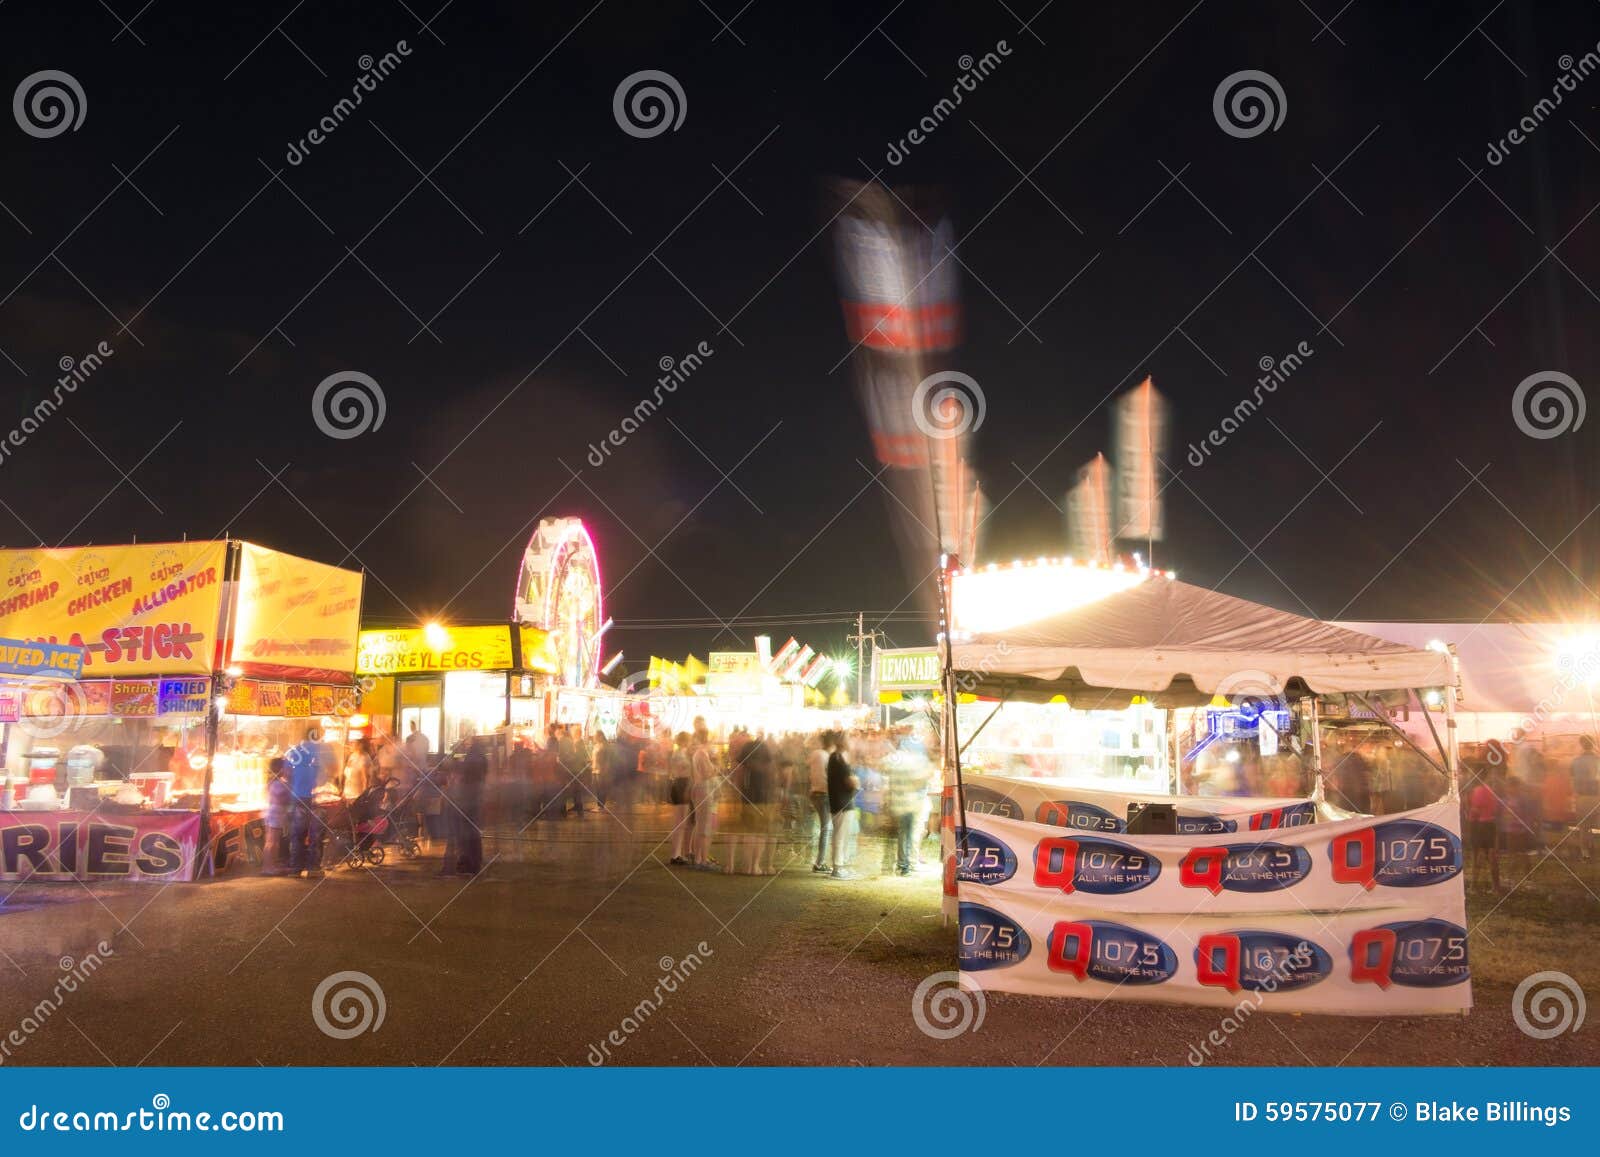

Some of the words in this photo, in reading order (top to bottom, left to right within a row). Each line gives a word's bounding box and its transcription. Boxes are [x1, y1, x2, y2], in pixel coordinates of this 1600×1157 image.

[67, 577, 133, 617] CHICKEN
[132, 567, 217, 615] ALLIGATOR
[49, 650, 80, 671] ICE
[882, 656, 939, 681] LEMONADE
[165, 682, 206, 695] FRIED
[161, 699, 207, 712] SHRIMP
[1071, 814, 1117, 830] 107.5
[1034, 837, 1080, 895] Q
[1081, 851, 1145, 870] 107.5
[1227, 851, 1291, 869] 107.5
[1332, 827, 1376, 892] Q
[1381, 837, 1448, 862] 107.5
[1404, 866, 1426, 874] THE
[1430, 865, 1457, 873] HITS
[960, 872, 980, 880] THE
[982, 872, 1007, 880] HITS
[1078, 874, 1100, 882] ALL
[1103, 874, 1124, 883] THE
[1126, 874, 1152, 883] HITS
[1226, 873, 1249, 881] ALL
[1251, 872, 1273, 880] THE
[1276, 871, 1302, 880] HITS
[962, 924, 1015, 947] 07.5
[974, 950, 993, 959] THE
[1047, 921, 1093, 983] Q
[1096, 939, 1160, 966] 107.5
[1350, 929, 1397, 991] Q
[1398, 937, 1465, 961] 107.5
[1197, 934, 1242, 996] Q
